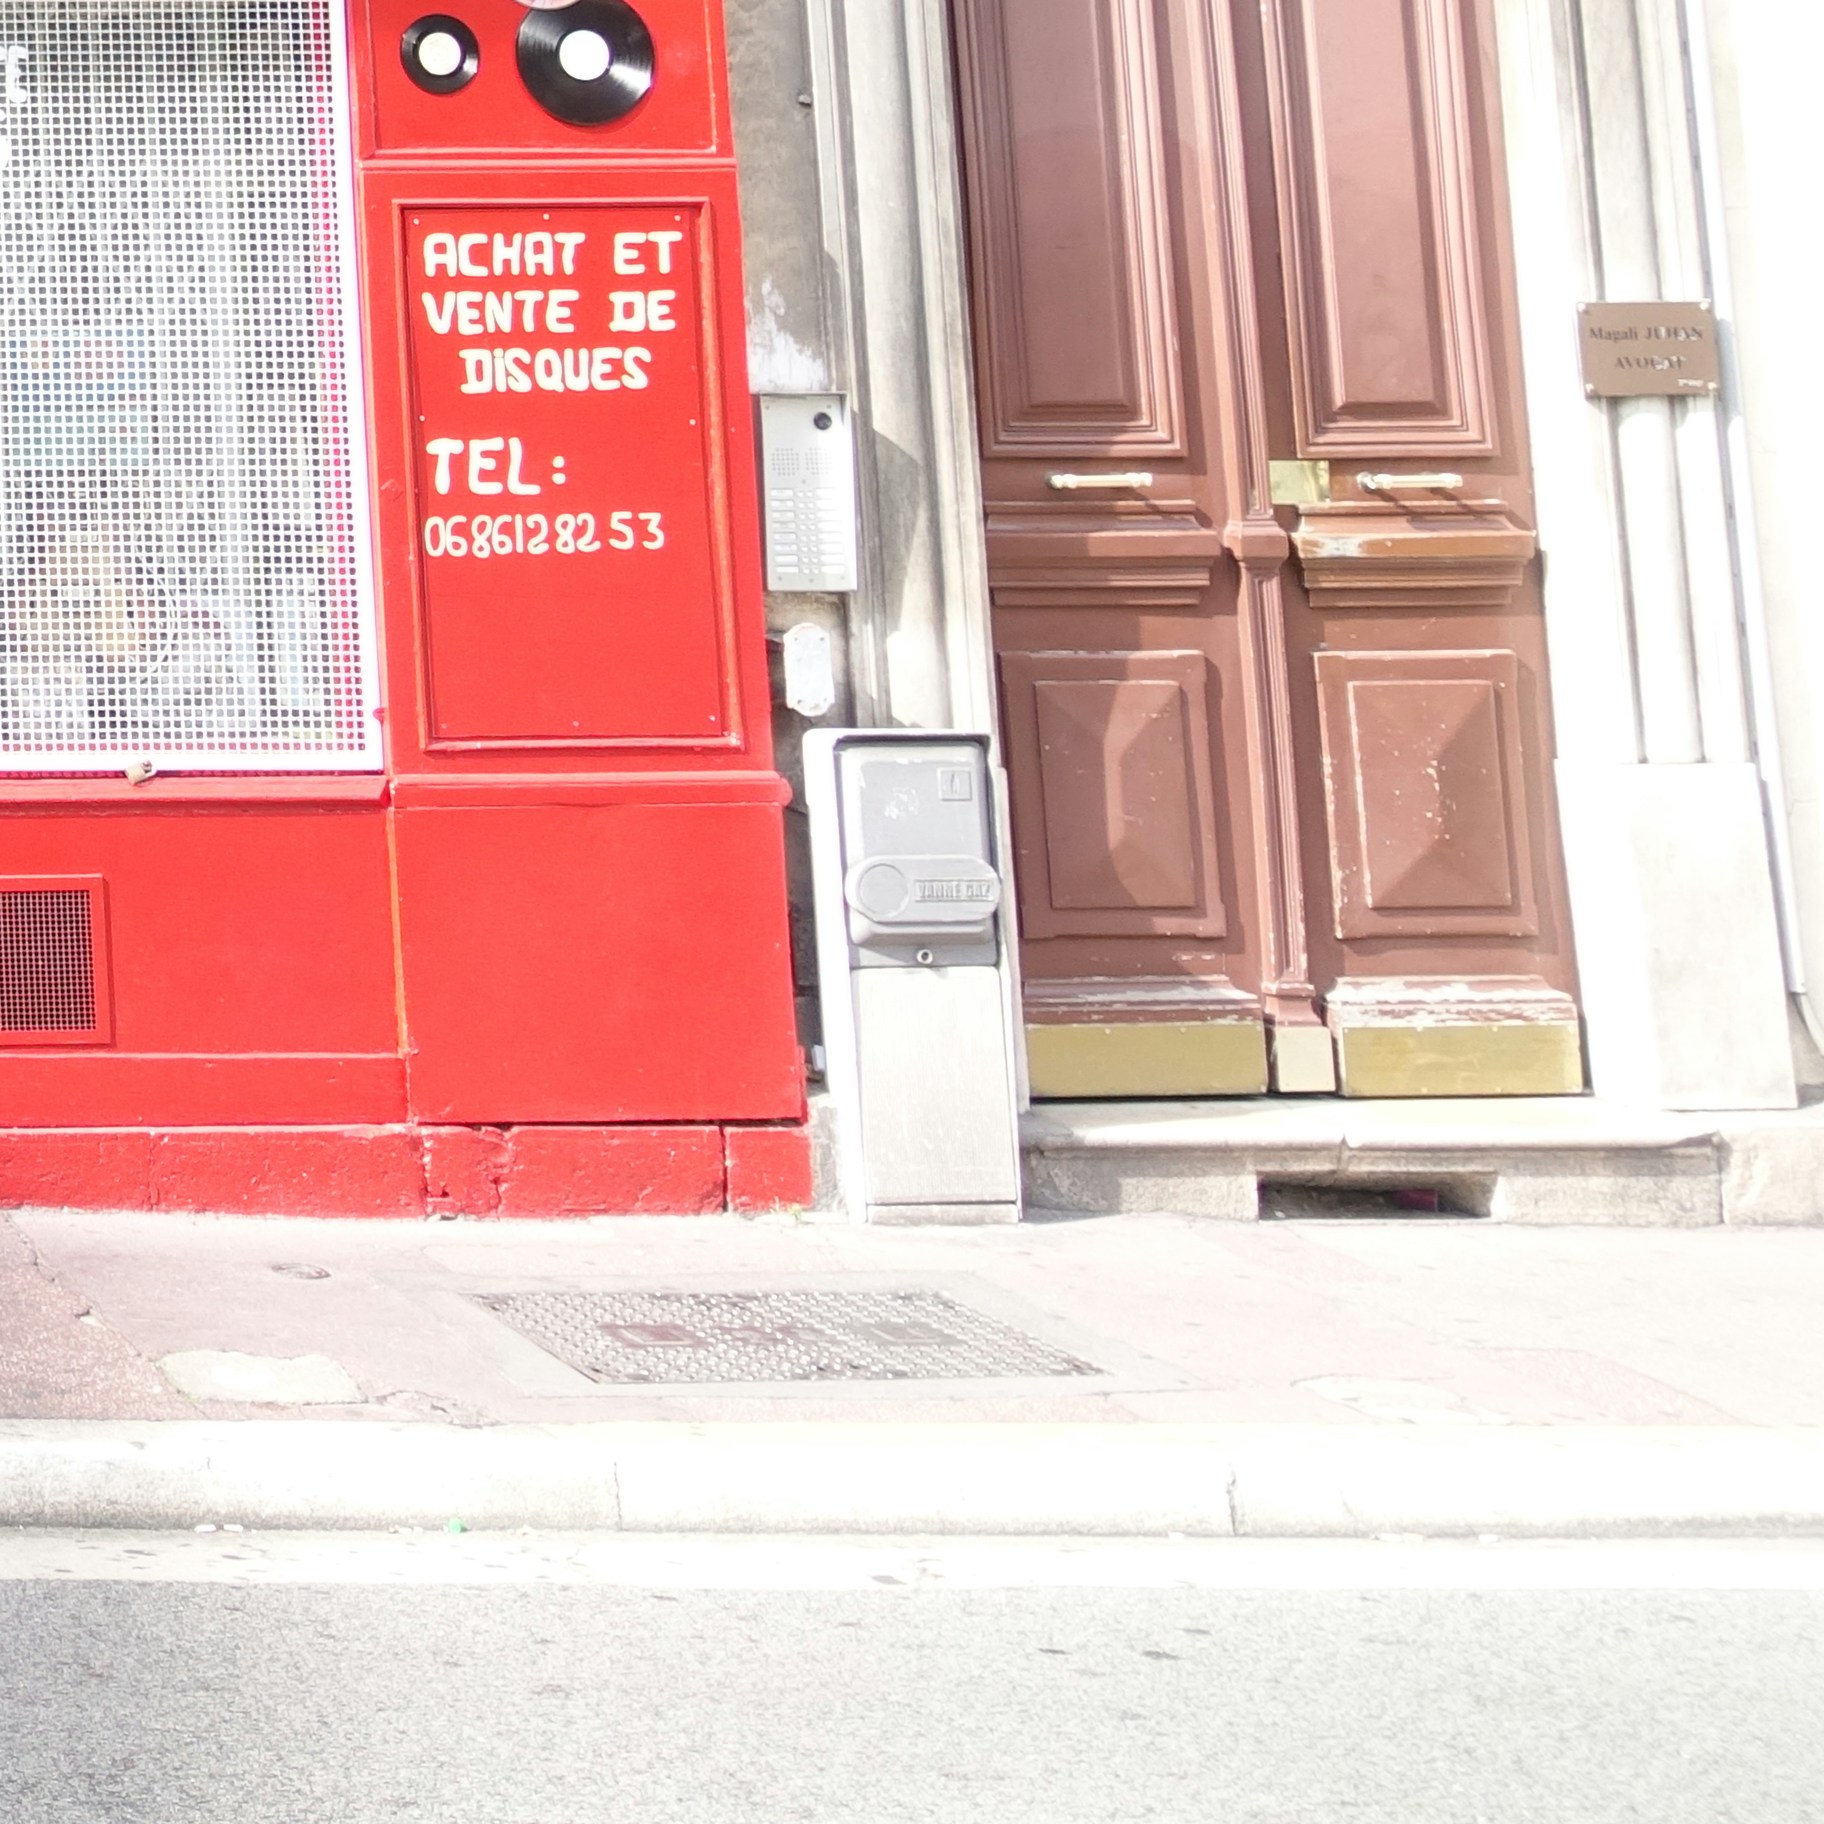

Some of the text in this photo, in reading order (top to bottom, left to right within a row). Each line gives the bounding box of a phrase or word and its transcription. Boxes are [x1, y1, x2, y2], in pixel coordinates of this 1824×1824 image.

[423, 230, 683, 277] ACHAT ET
[421, 289, 677, 336] VENTE DE
[1589, 327, 1639, 343] Magali
